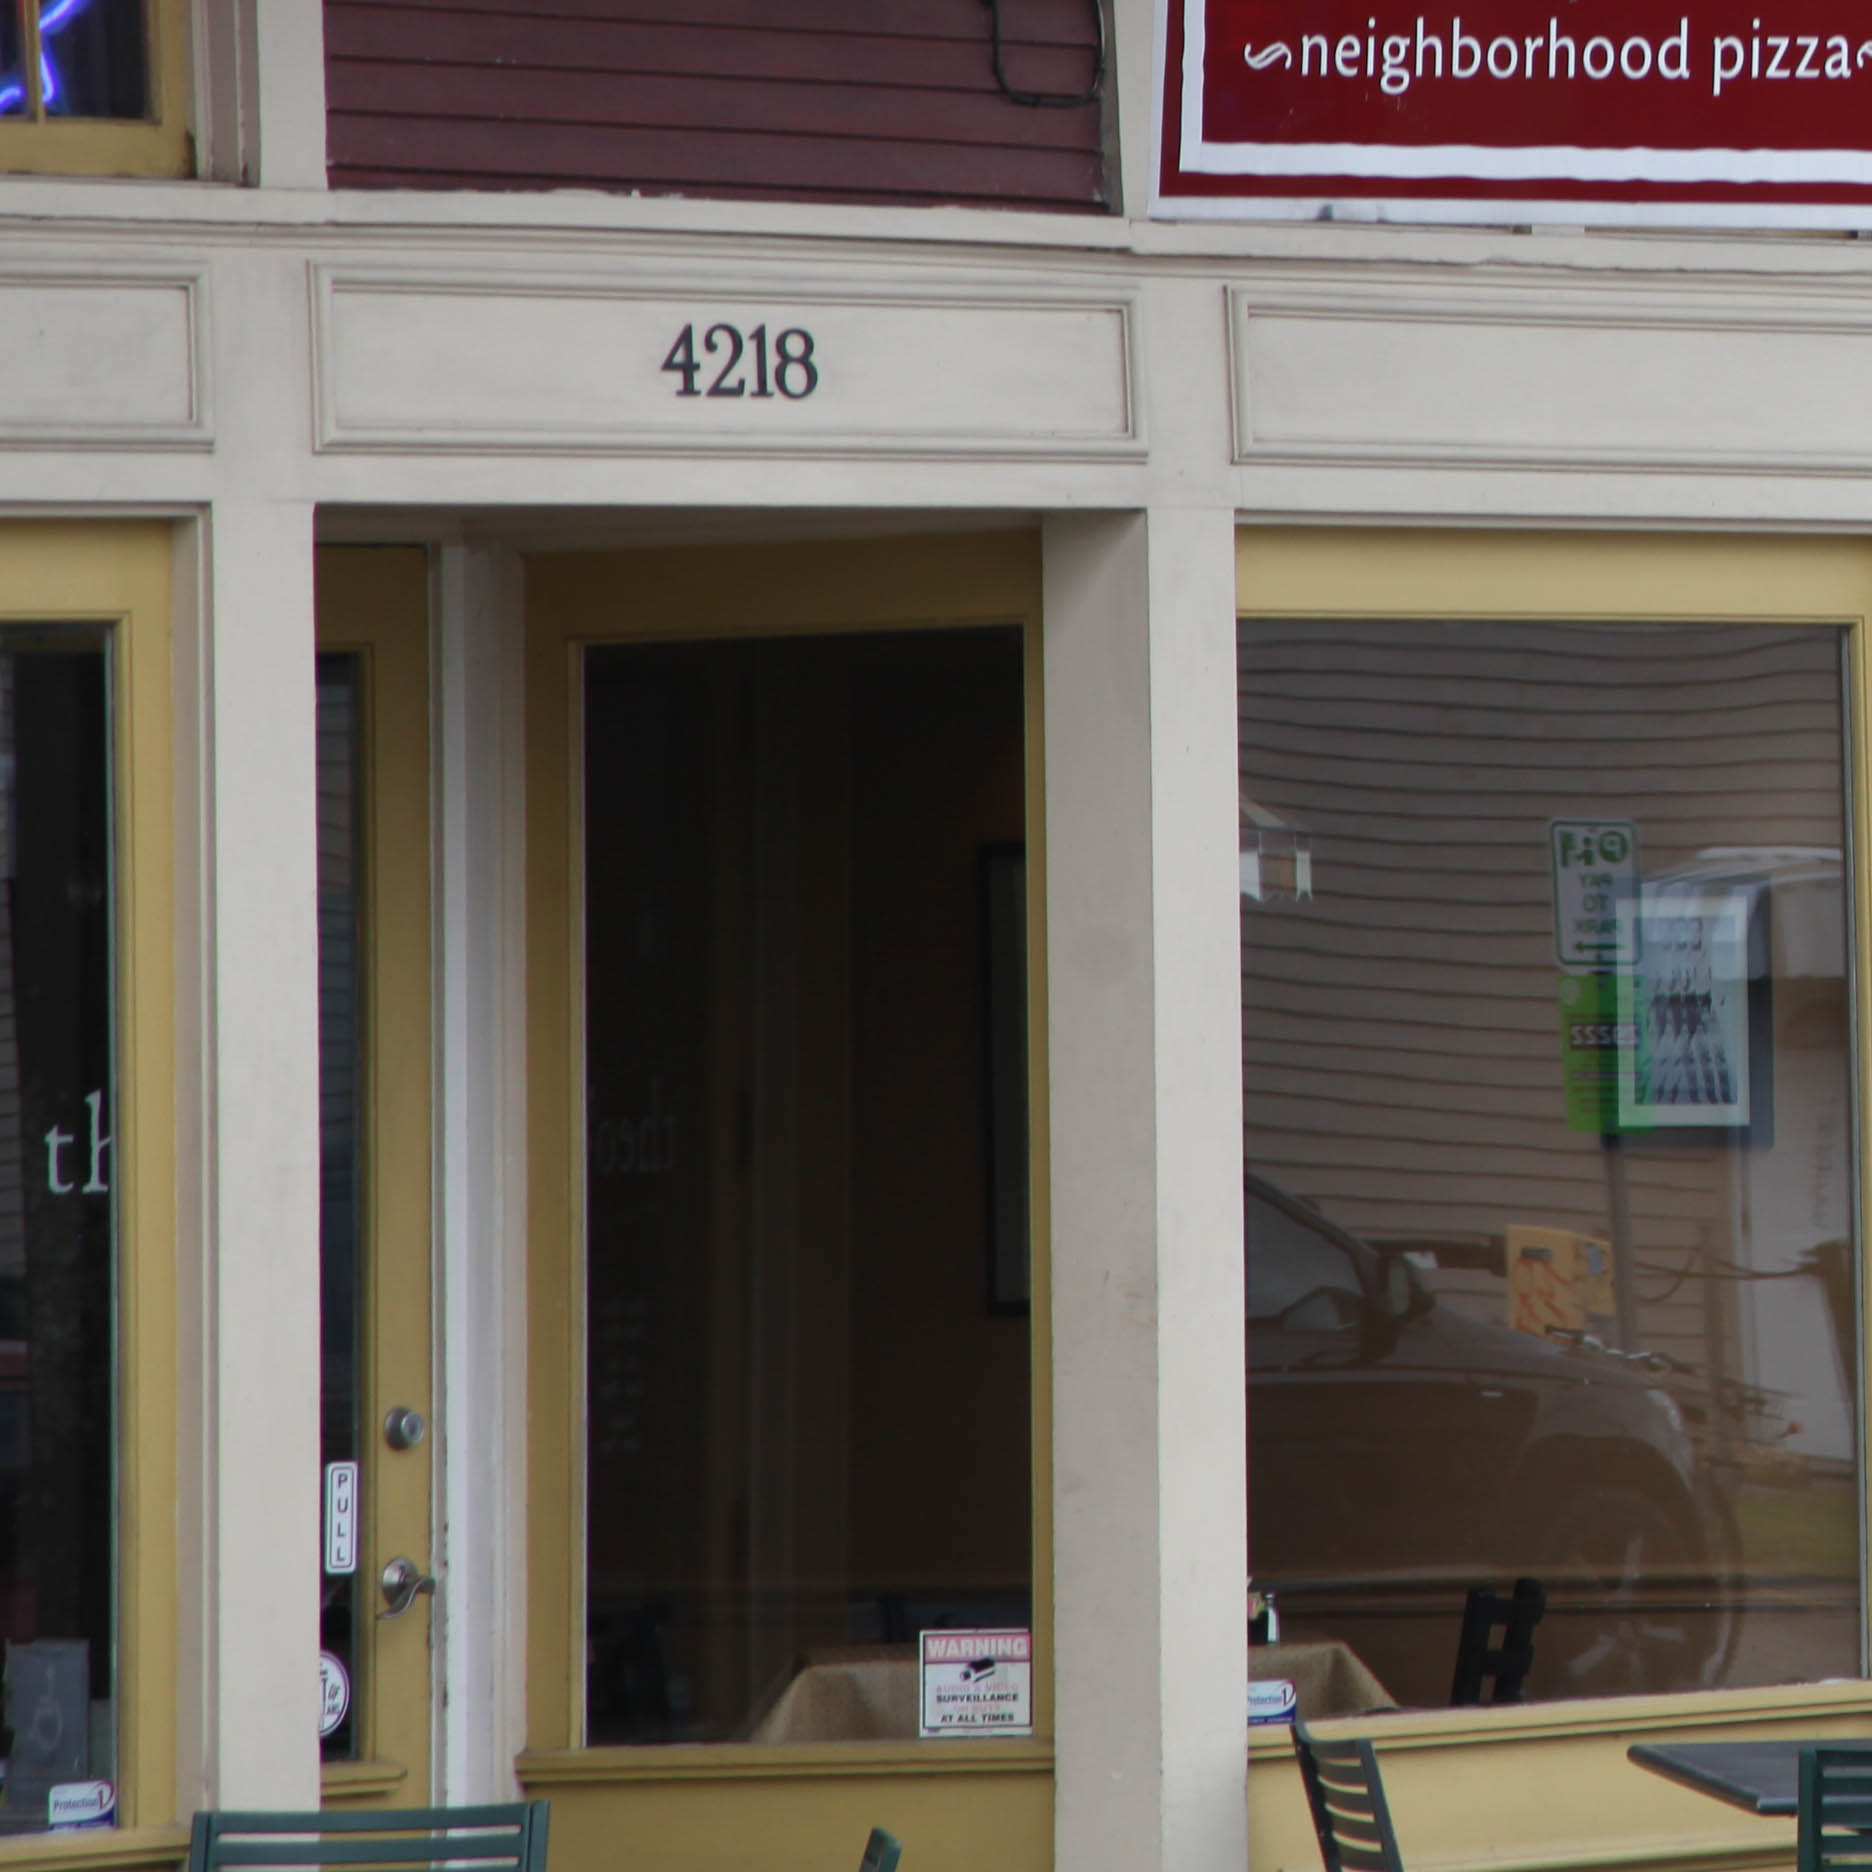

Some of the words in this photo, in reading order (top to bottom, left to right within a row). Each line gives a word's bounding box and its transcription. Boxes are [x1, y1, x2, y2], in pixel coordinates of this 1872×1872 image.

[661, 323, 819, 400] 4218
[337, 1472, 349, 1562] PULL
[926, 1636, 1028, 1658] WARNING
[936, 1692, 1019, 1704] SURVEILLANCE
